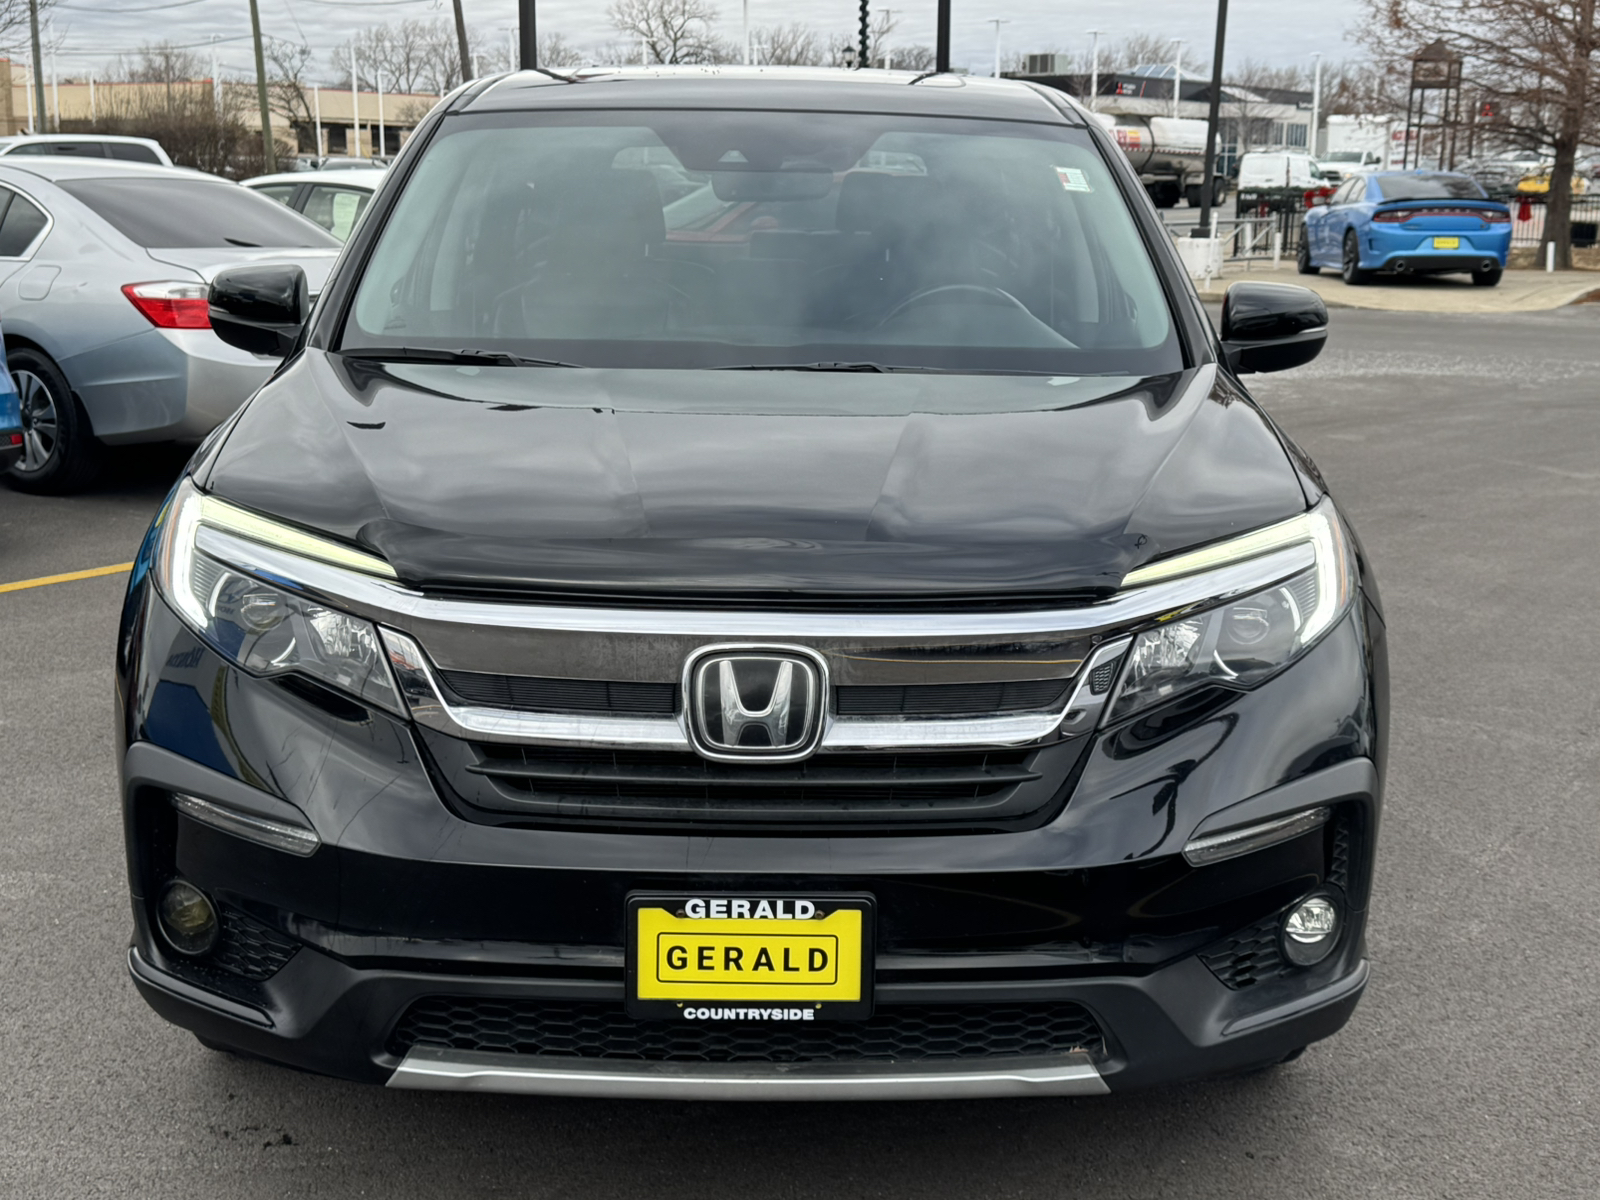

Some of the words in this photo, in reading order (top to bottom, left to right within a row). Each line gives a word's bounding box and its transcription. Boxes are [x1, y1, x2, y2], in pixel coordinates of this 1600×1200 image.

[719, 660, 794, 747] H
[684, 898, 816, 920] GERALD
[666, 945, 829, 972] GERALD
[683, 1007, 815, 1021] COUNTRYSIDE
